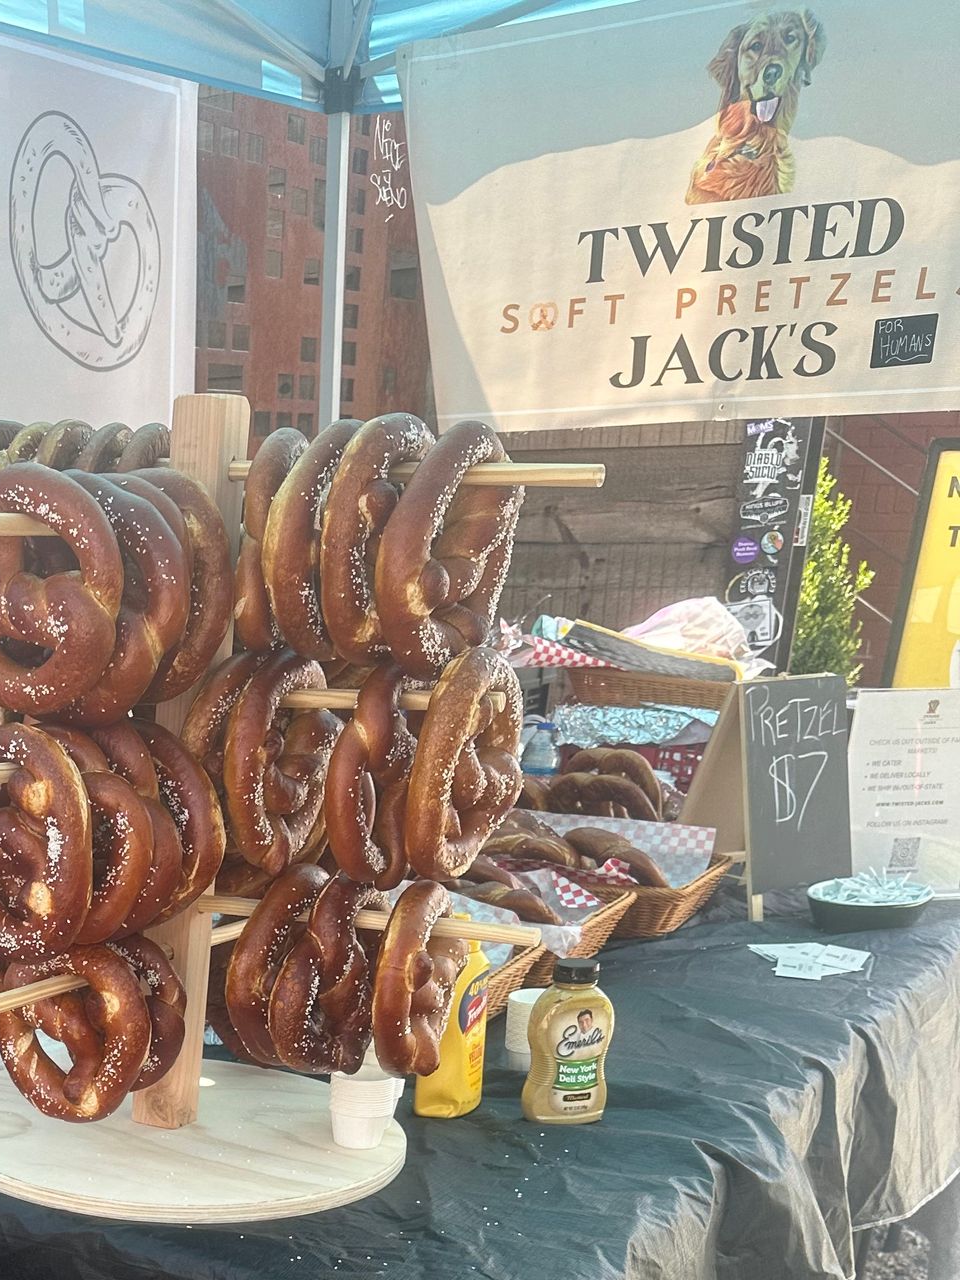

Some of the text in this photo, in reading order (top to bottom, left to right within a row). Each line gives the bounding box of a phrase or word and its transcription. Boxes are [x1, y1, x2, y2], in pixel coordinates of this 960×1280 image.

[577, 197, 906, 284] TWISTED
[675, 266, 960, 320] PRETZEL
[878, 318, 904, 334] FOR
[609, 321, 838, 390] JACK'S
[880, 333, 933, 360] HUMANS
[745, 451, 783, 467] DIABLO
[748, 465, 778, 480] SUCIO
[745, 685, 848, 747] PRETZEL
[904, 771, 931, 779] LOCALLY
[768, 751, 829, 832] $7
[556, 1024, 605, 1057] Emeril's
[559, 1062, 597, 1074] New York
[559, 1072, 596, 1084] Deli Style
